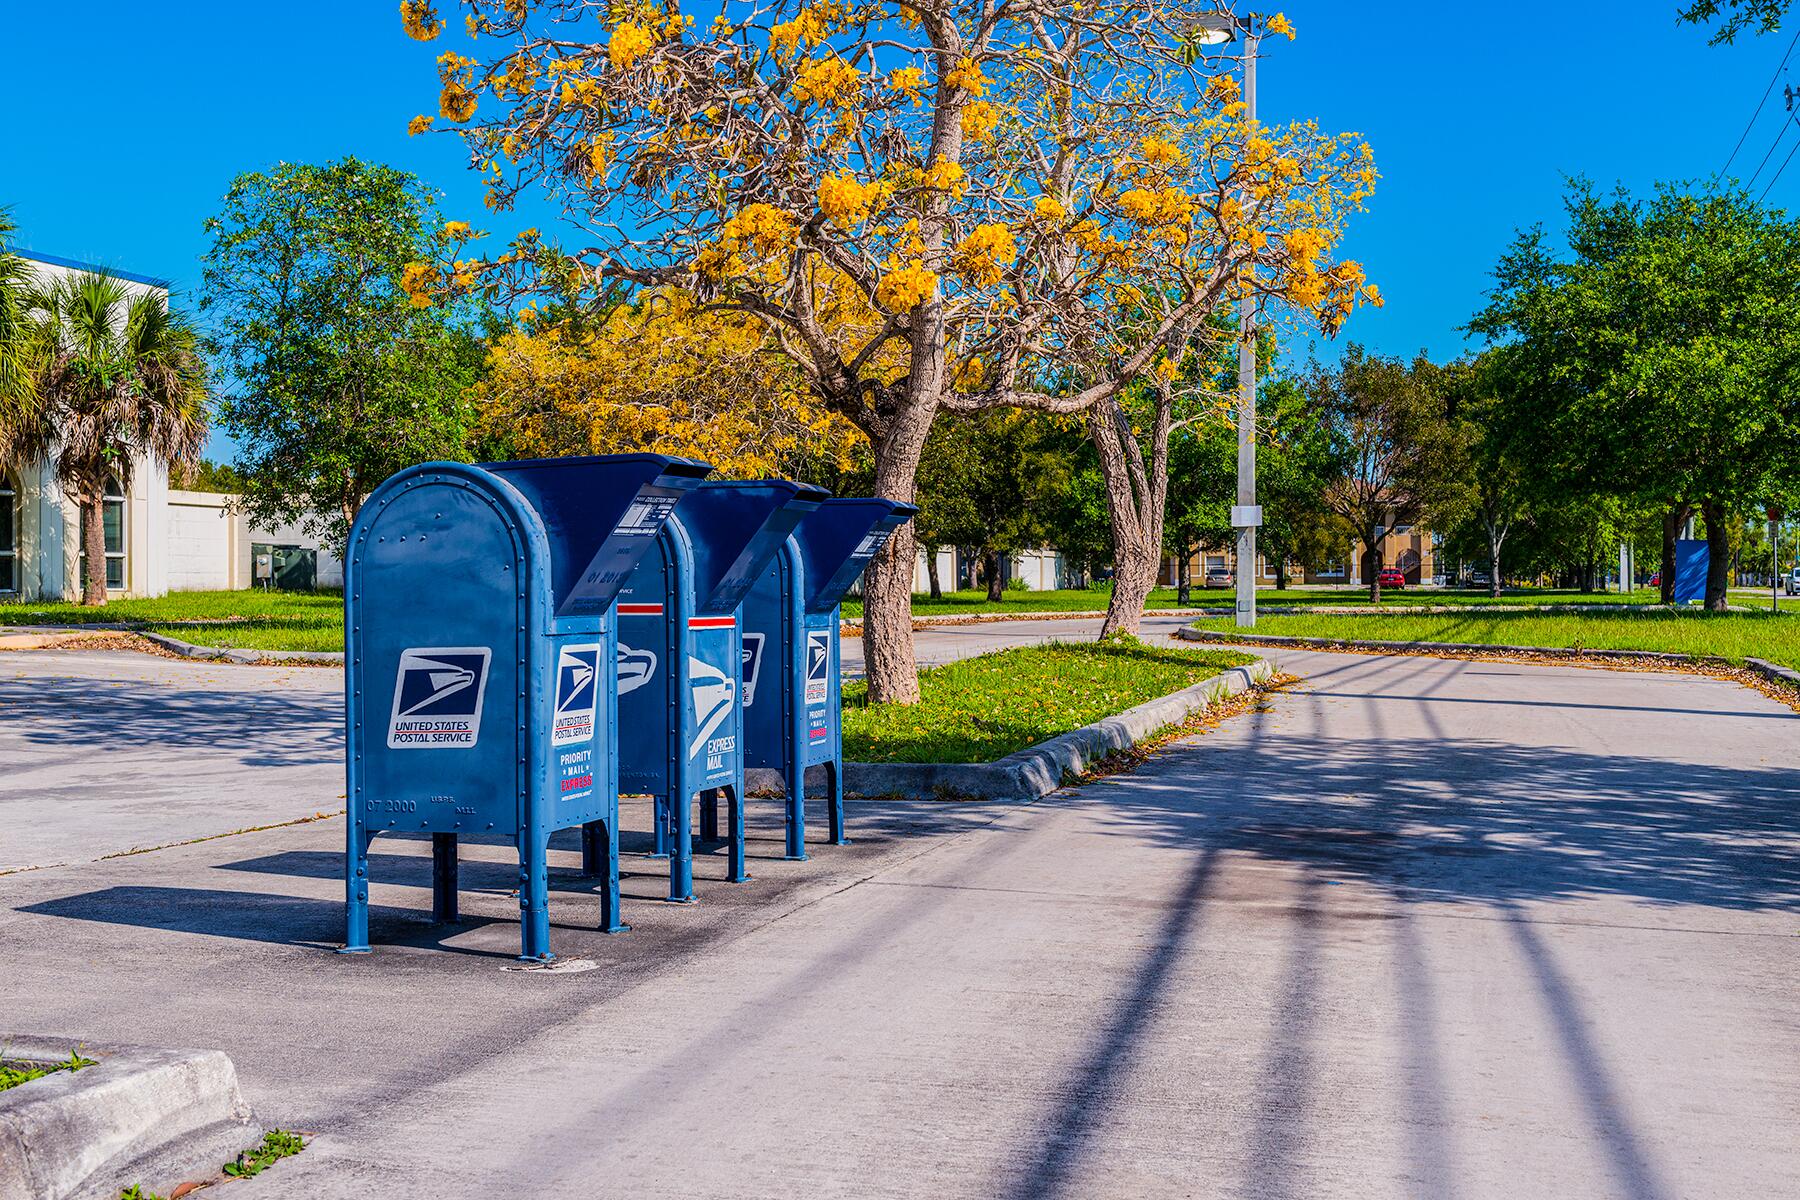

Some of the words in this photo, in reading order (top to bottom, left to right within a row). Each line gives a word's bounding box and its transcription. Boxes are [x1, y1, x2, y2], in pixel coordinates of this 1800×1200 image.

[555, 716, 574, 728] UNITED
[573, 714, 591, 726] STATES
[809, 709, 826, 720] PRIORITY
[394, 721, 433, 732] UNITED
[434, 721, 469, 731] STATES
[554, 728, 573, 740] POSTAL
[572, 725, 592, 737] SERVICE
[393, 733, 430, 743] POSTAL
[431, 732, 472, 743] SERVICE
[707, 735, 735, 754] EXPRESS
[560, 749, 592, 766] PRIORITY
[706, 754, 723, 771] MAIL
[567, 764, 585, 776] MAIL
[561, 774, 592, 792] EXPRESS
[384, 799, 417, 813] 2000
